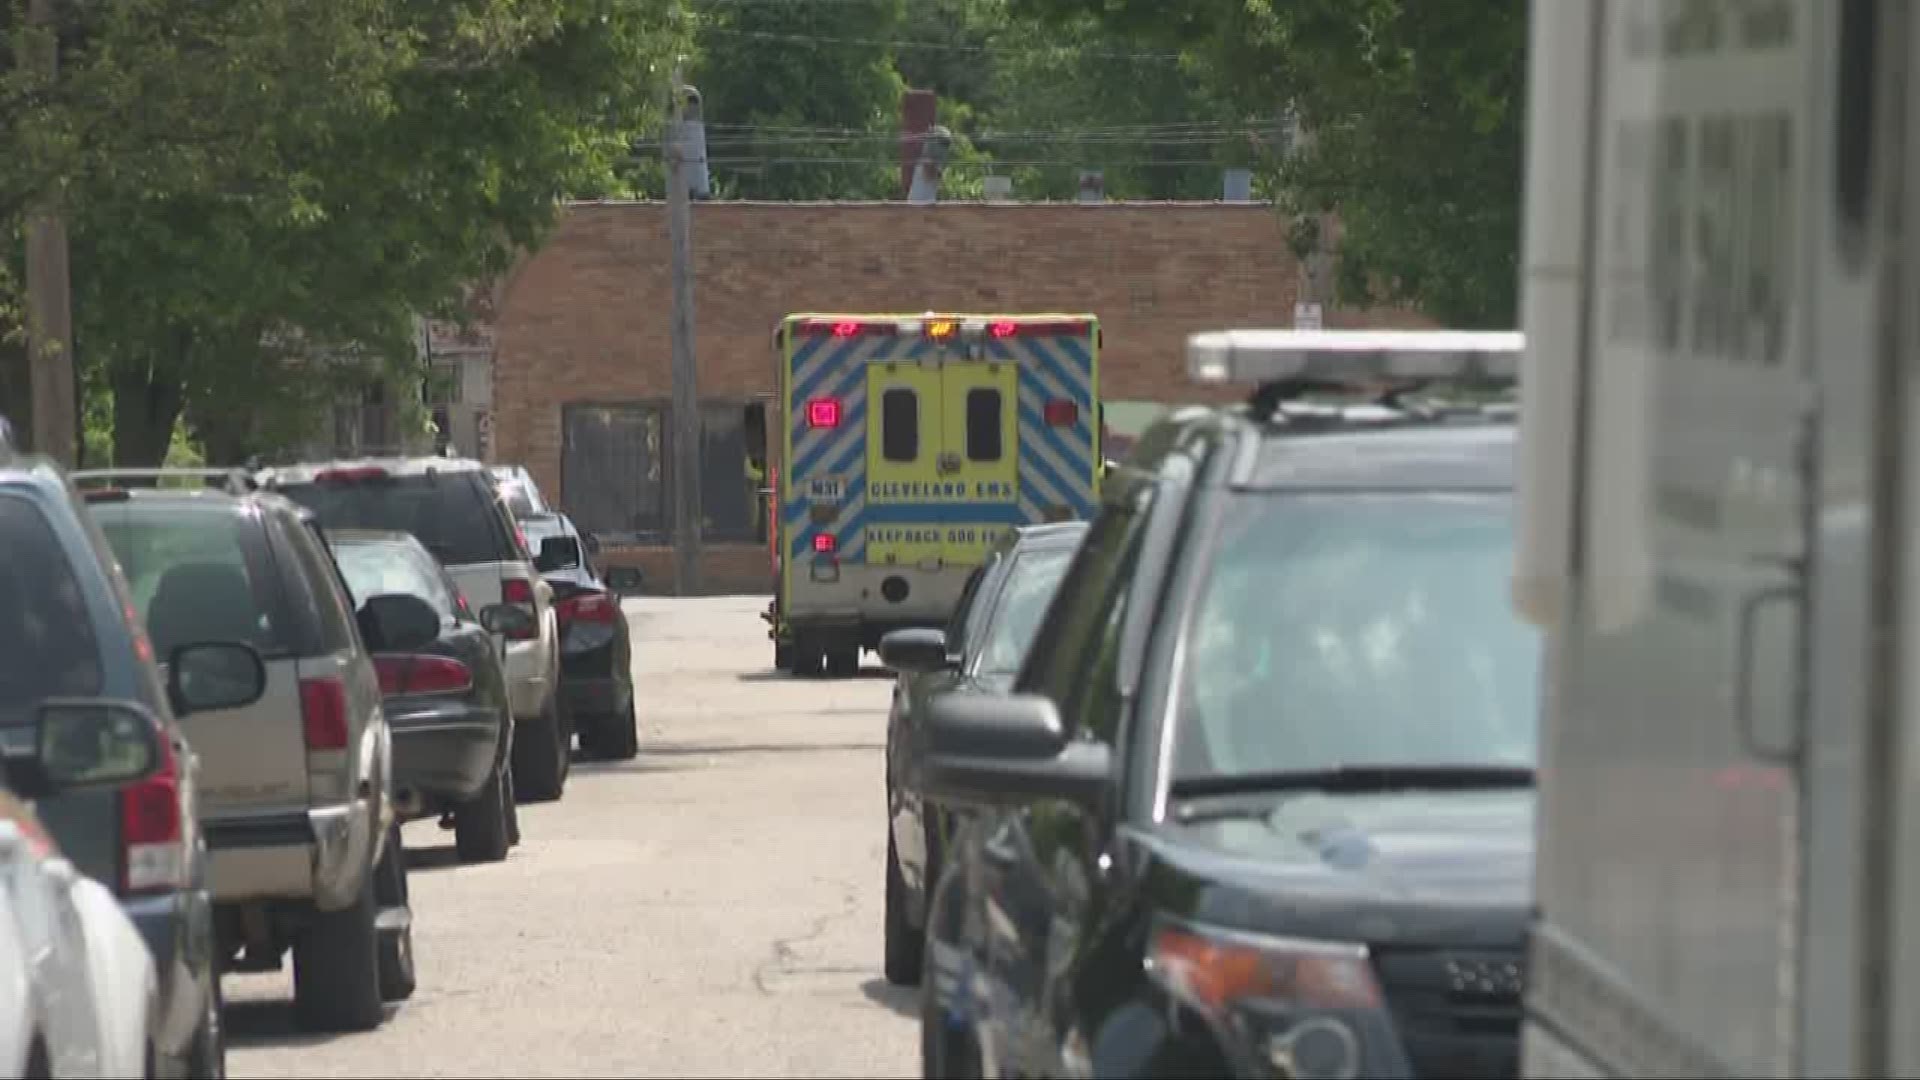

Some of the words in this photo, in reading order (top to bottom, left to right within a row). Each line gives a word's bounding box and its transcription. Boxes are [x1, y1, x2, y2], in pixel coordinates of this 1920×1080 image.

[870, 481, 966, 496] CLEVELAND
[976, 481, 1012, 496] EMS
[905, 528, 940, 543] BACK
